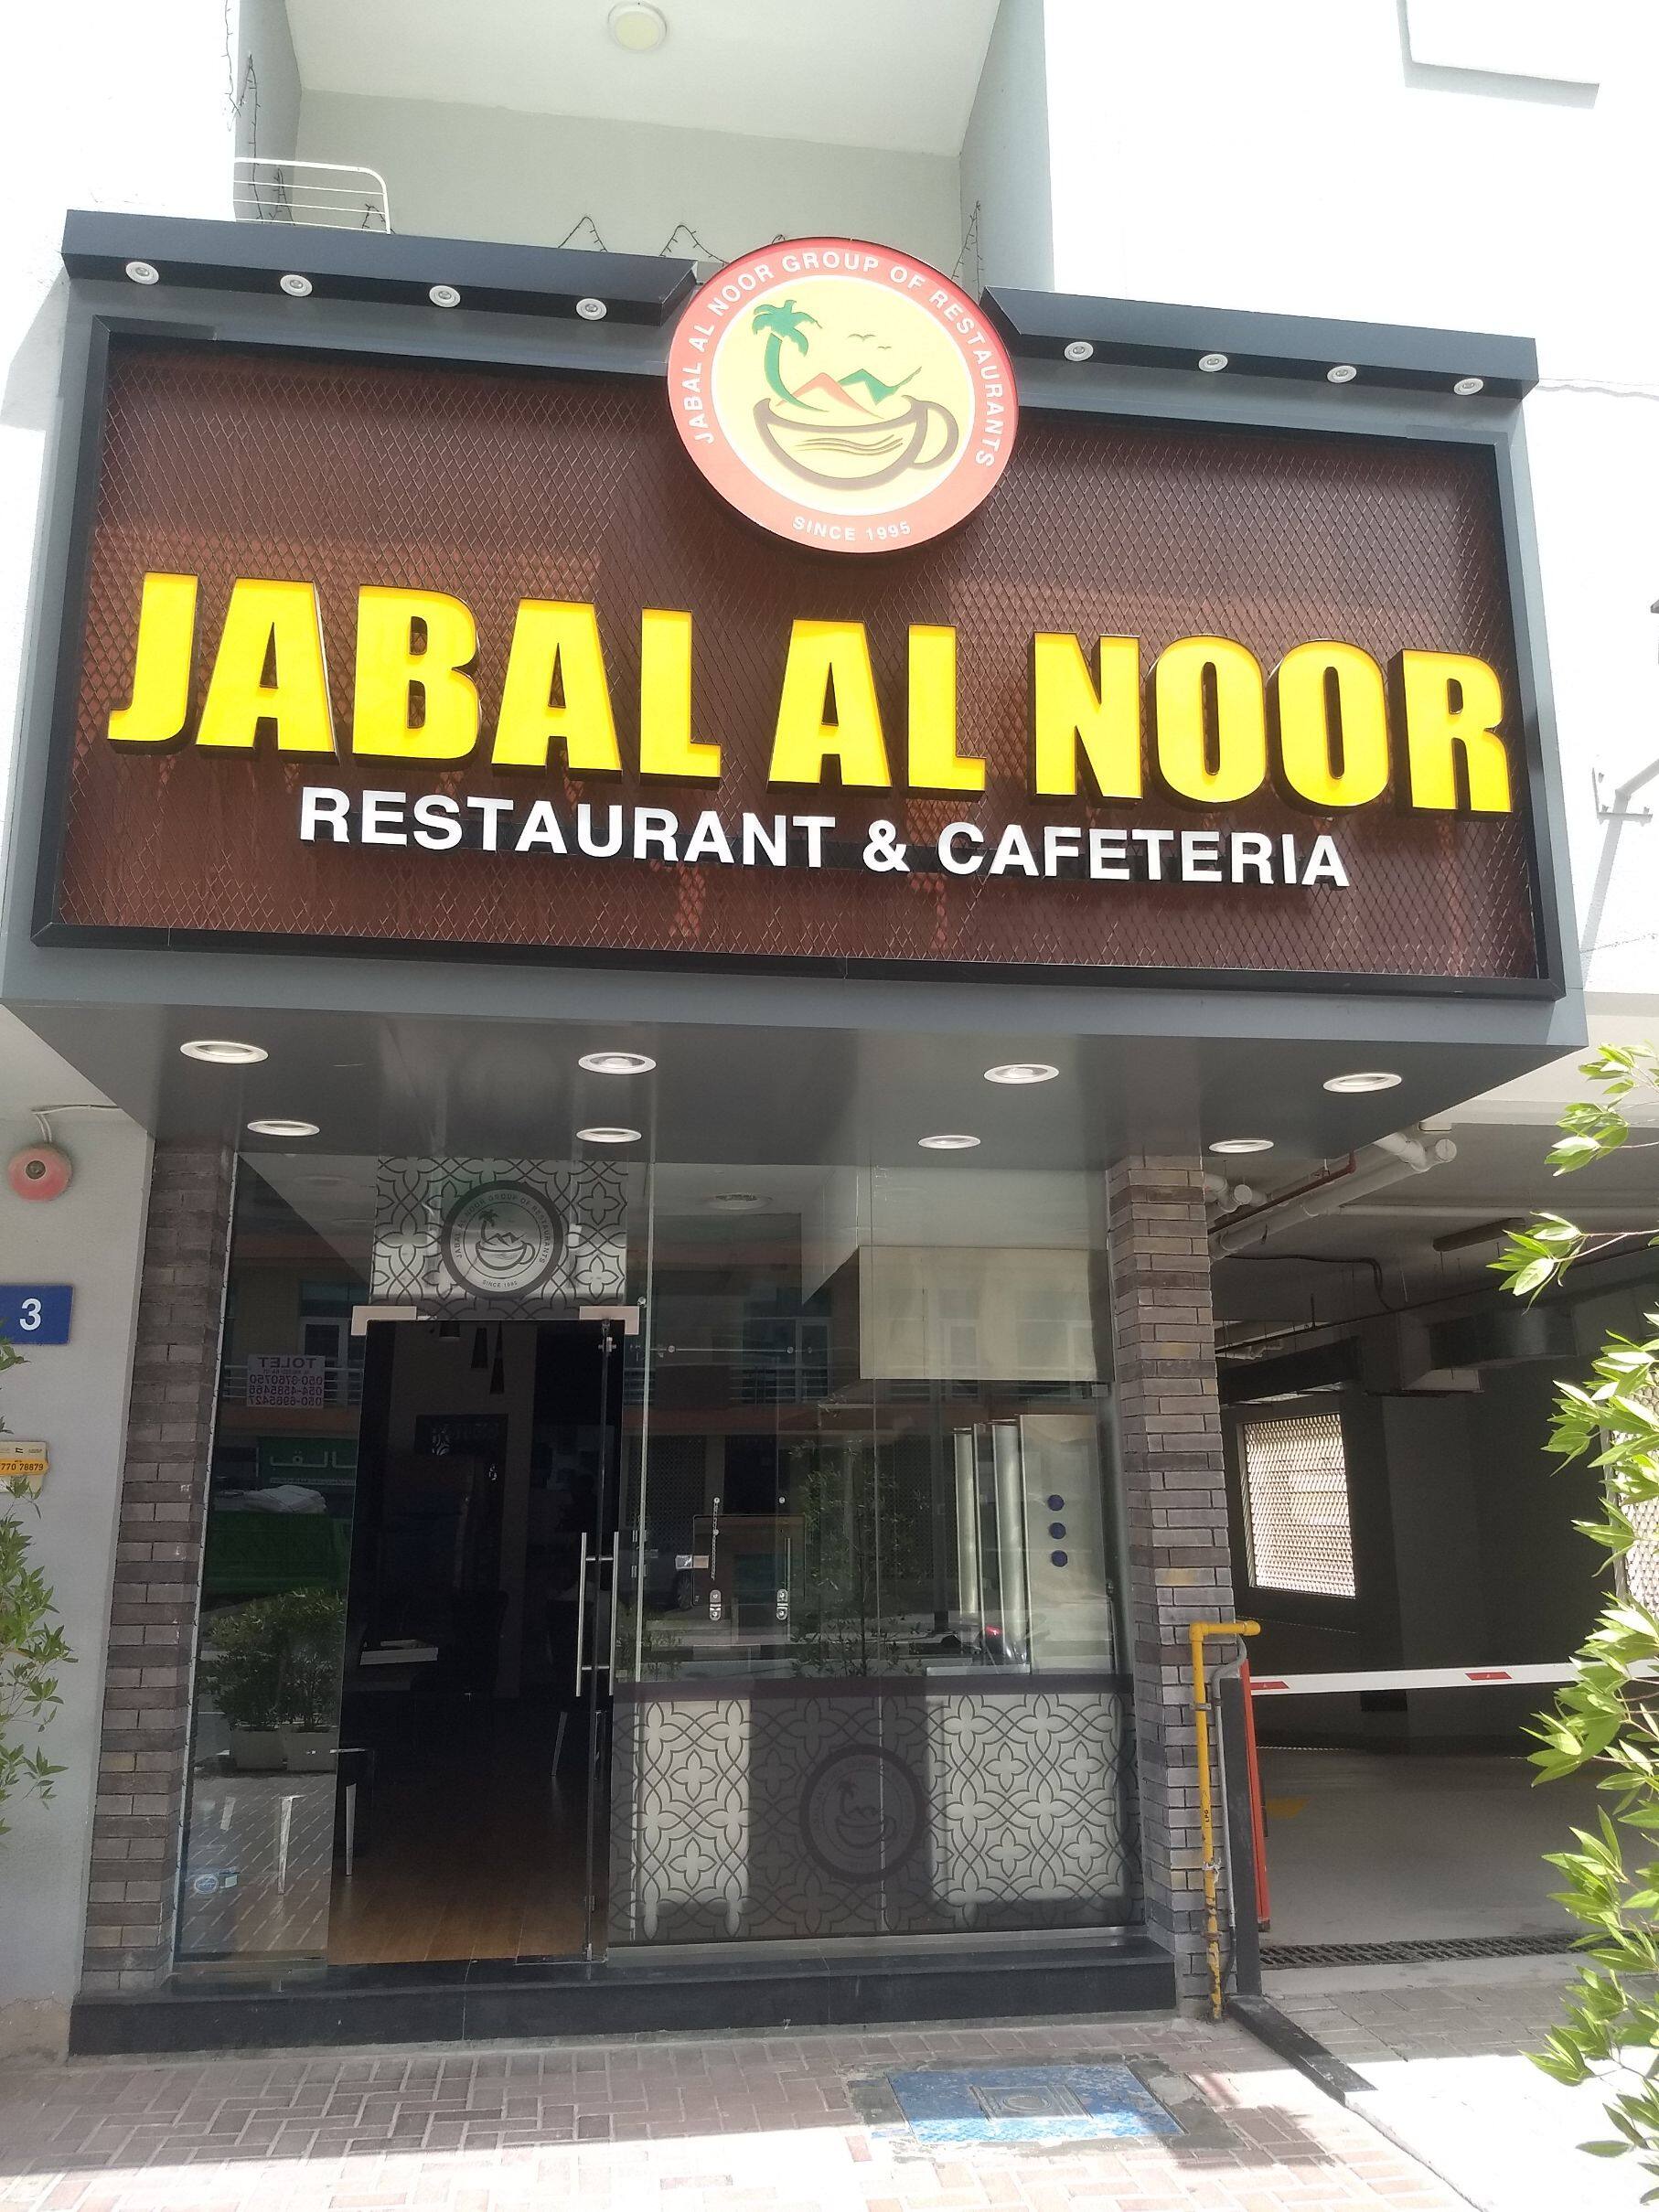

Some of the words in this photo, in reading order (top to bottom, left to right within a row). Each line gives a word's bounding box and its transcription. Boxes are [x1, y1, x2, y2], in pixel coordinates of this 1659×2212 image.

[782, 251, 879, 272] GROUP
[889, 264, 927, 291] OF
[707, 263, 775, 316] NOOR
[688, 323, 715, 353] AL
[928, 289, 1005, 467] RESTAURANTS
[681, 363, 715, 444] JABAL
[791, 515, 857, 542] SINCE
[866, 519, 912, 542] 1995
[107, 572, 724, 783] JABAL
[765, 618, 987, 794] AL
[1032, 630, 1514, 814] NOOR
[298, 785, 837, 871] RESTAURANT
[862, 818, 911, 873] &
[937, 820, 1351, 888] CAFETERIA
[19, 1298, 42, 1331] 3
[19, 1463, 44, 1471] 78879
